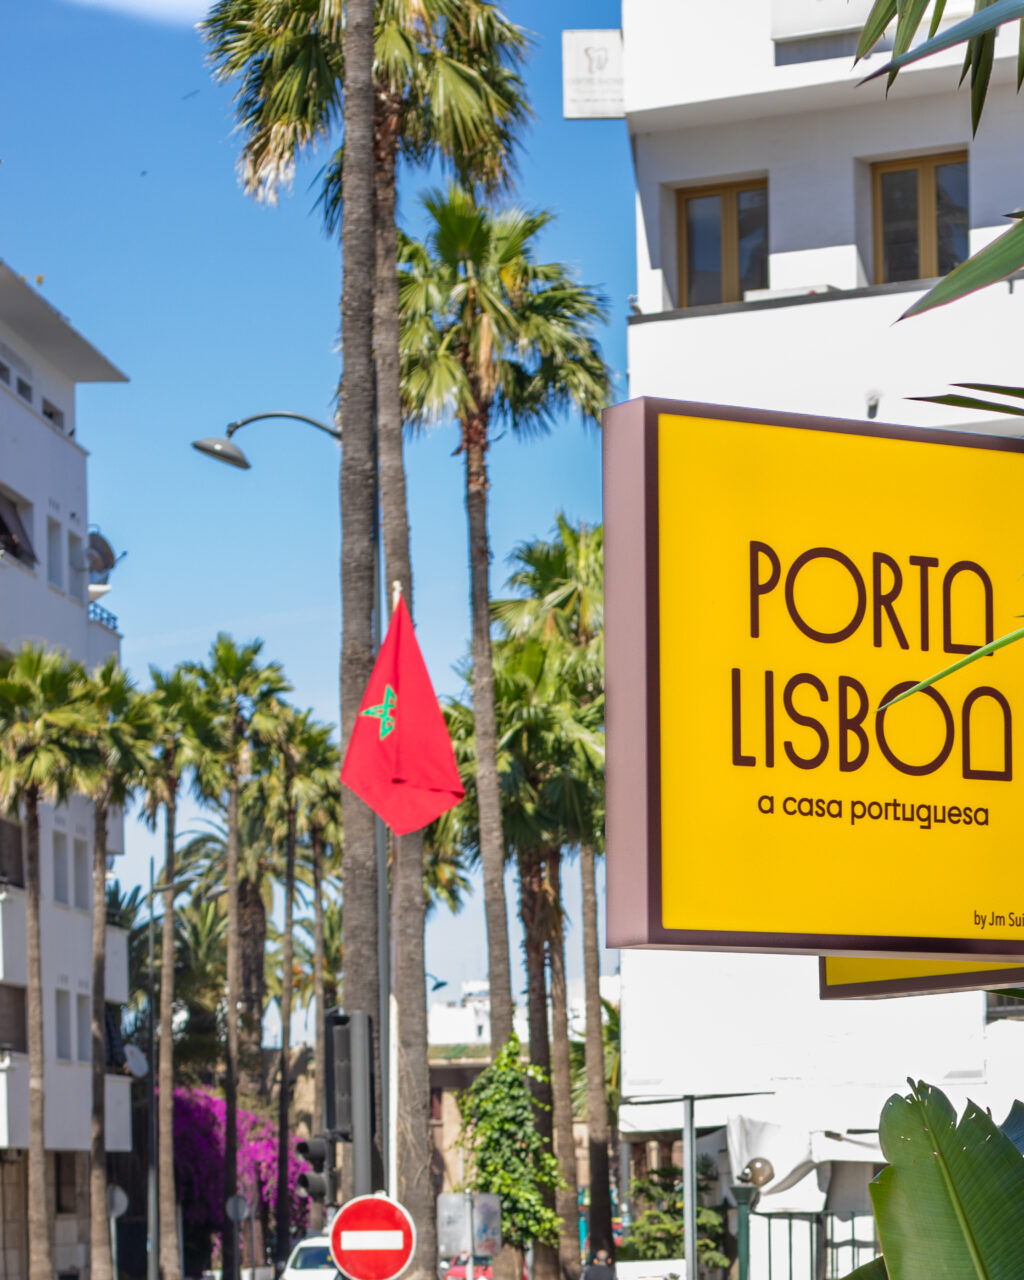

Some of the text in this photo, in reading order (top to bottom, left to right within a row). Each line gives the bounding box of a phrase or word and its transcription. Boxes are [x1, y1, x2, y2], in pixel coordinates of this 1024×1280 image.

[749, 540, 995, 657] PORTA
[731, 667, 1013, 783] LISBOA
[757, 794, 989, 830] a casa portuguesa
[974, 909, 987, 930] by
[988, 911, 1006, 927] Jm
